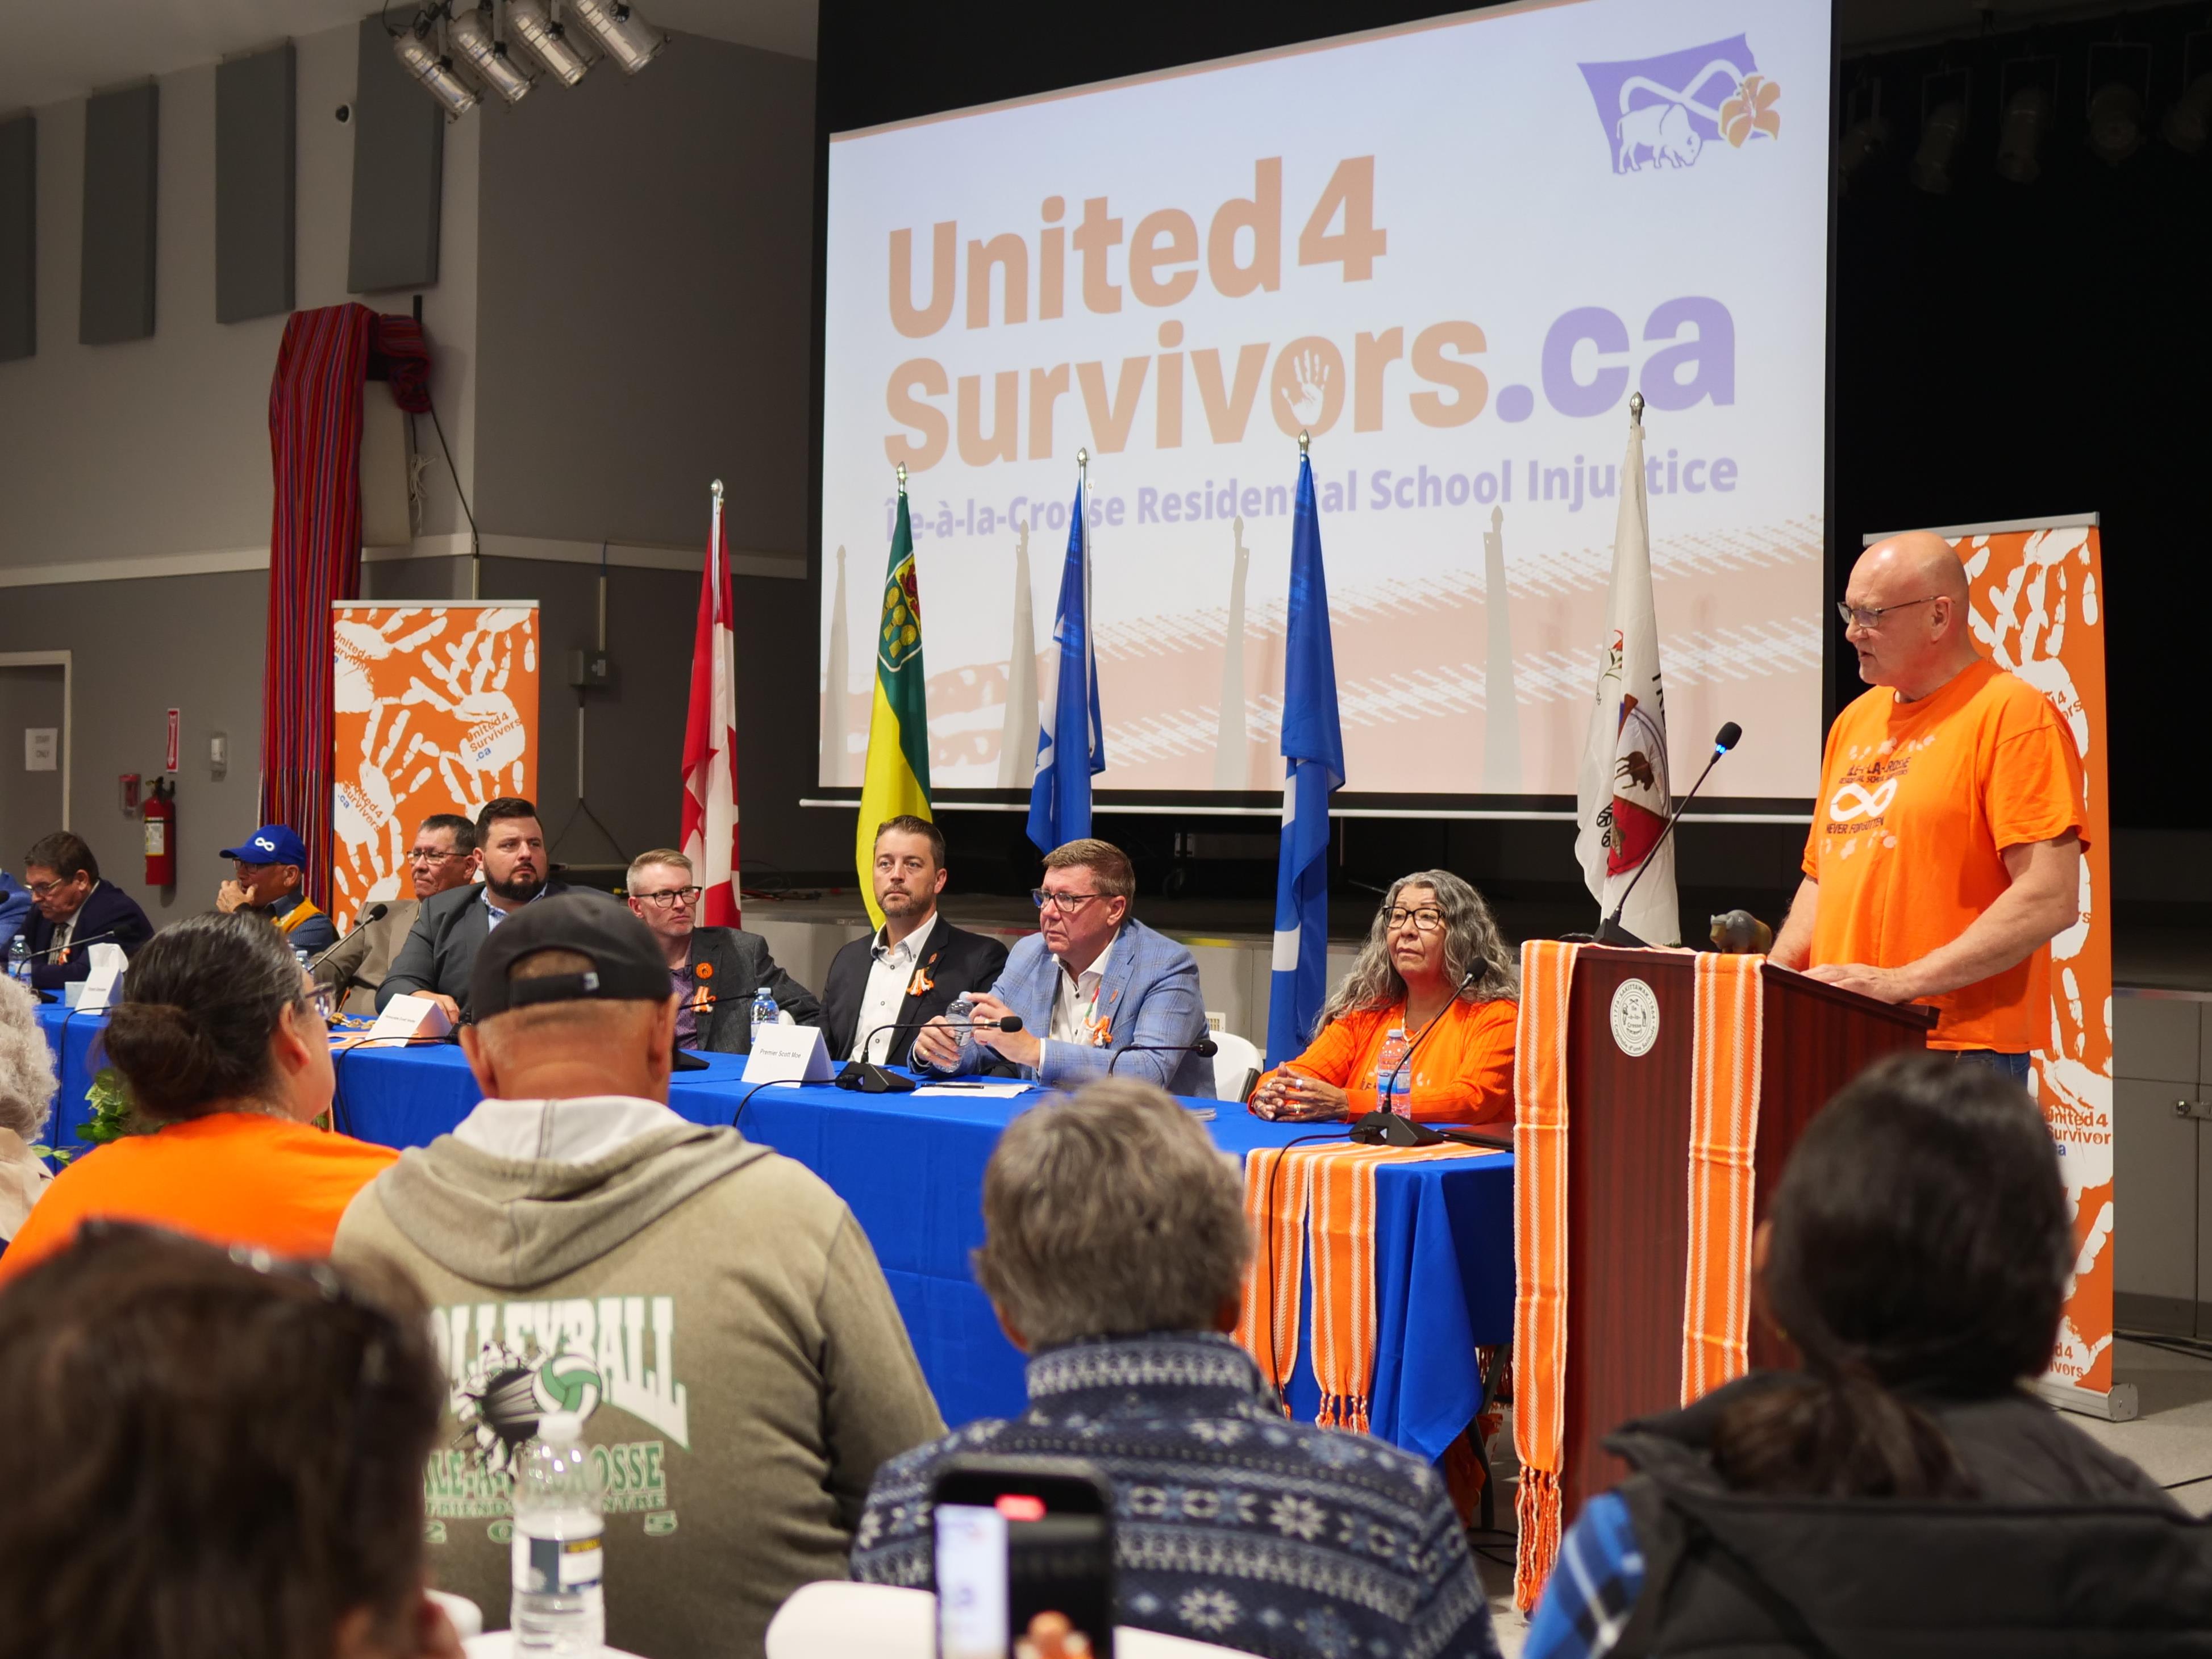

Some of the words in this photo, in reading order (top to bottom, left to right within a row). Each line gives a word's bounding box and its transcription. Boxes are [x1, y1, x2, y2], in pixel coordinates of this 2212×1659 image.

[884, 296, 1735, 473] Survivors.ca
[884, 496, 1125, 542] Îe-à-la-Crose
[1370, 460, 1511, 511] School
[1527, 448, 1738, 512] Injutice
[470, 718, 522, 752] Survivors
[476, 747, 491, 762] .ca
